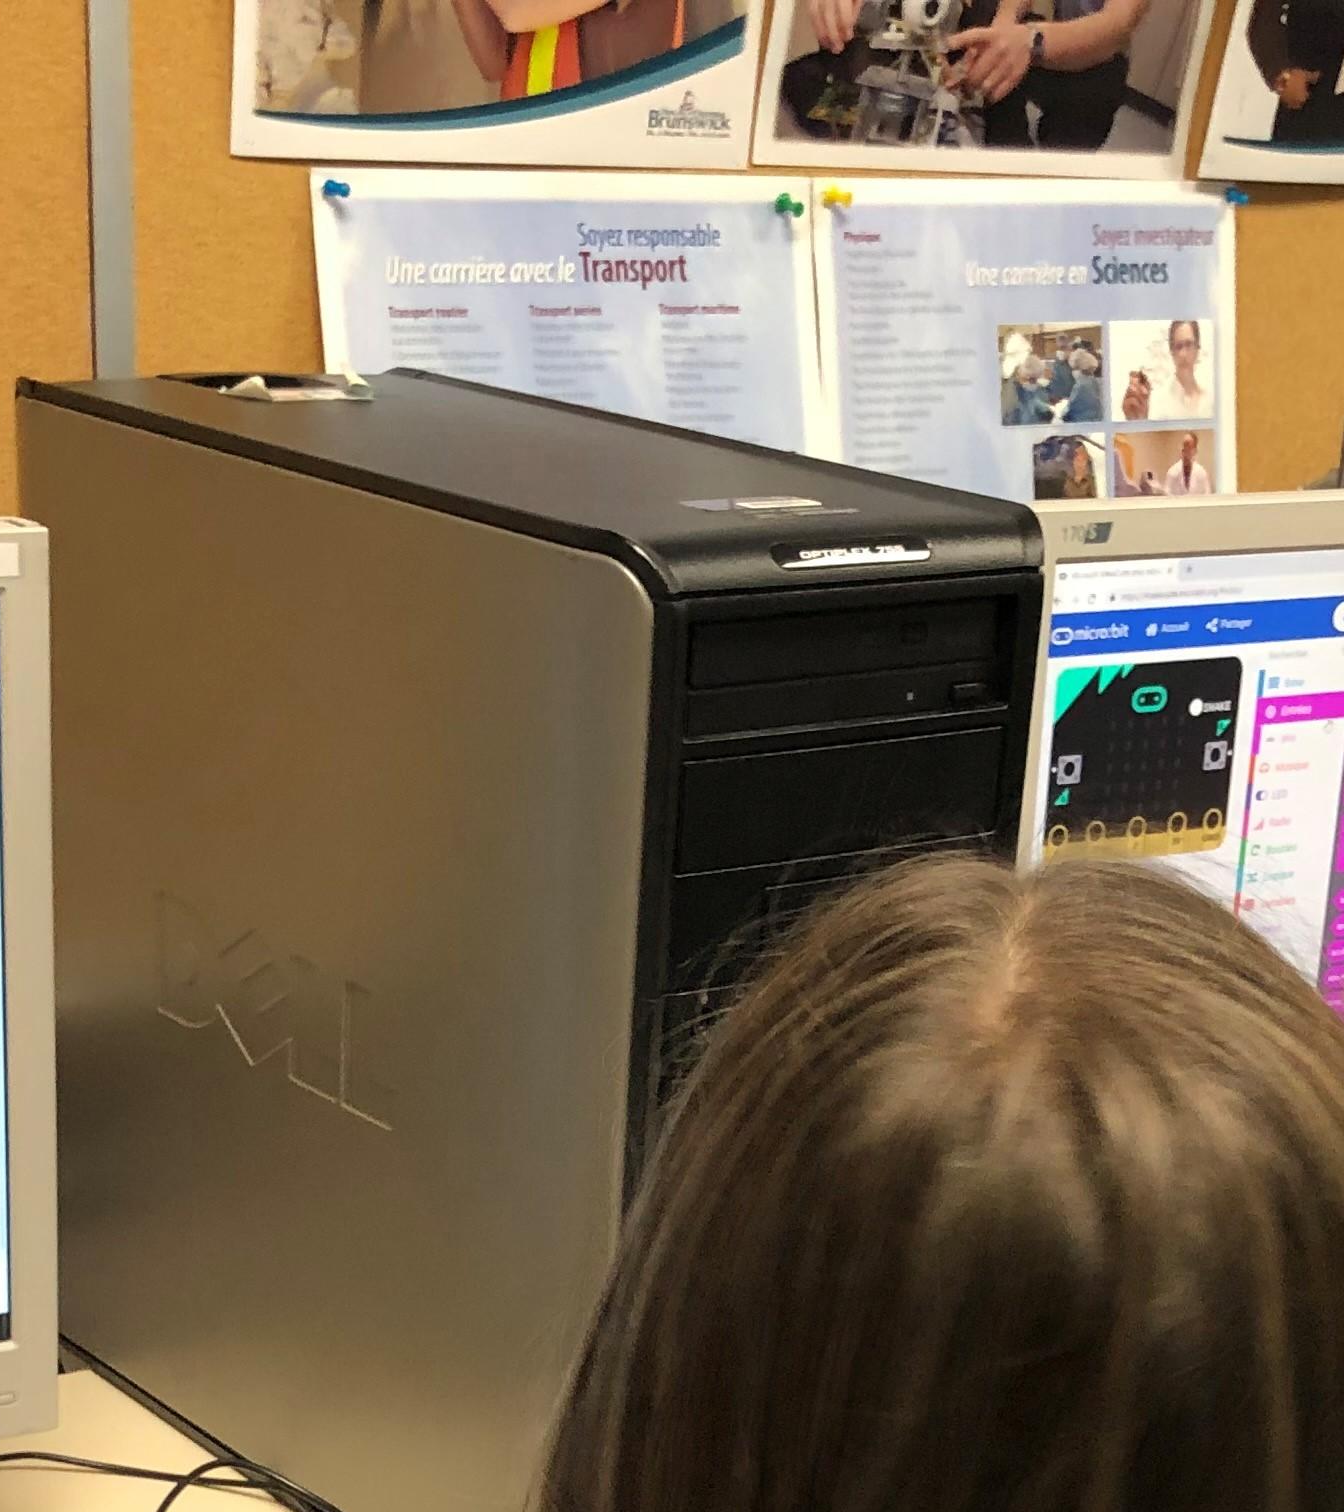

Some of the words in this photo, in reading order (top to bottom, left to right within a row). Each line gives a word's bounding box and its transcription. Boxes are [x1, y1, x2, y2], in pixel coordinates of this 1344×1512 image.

[577, 222, 624, 252] Soyez
[627, 223, 721, 251] responsable
[386, 256, 425, 284] Une
[510, 262, 554, 284] avec
[559, 255, 576, 284] le
[578, 252, 688, 290] Transport
[1091, 256, 1169, 285] Sciences
